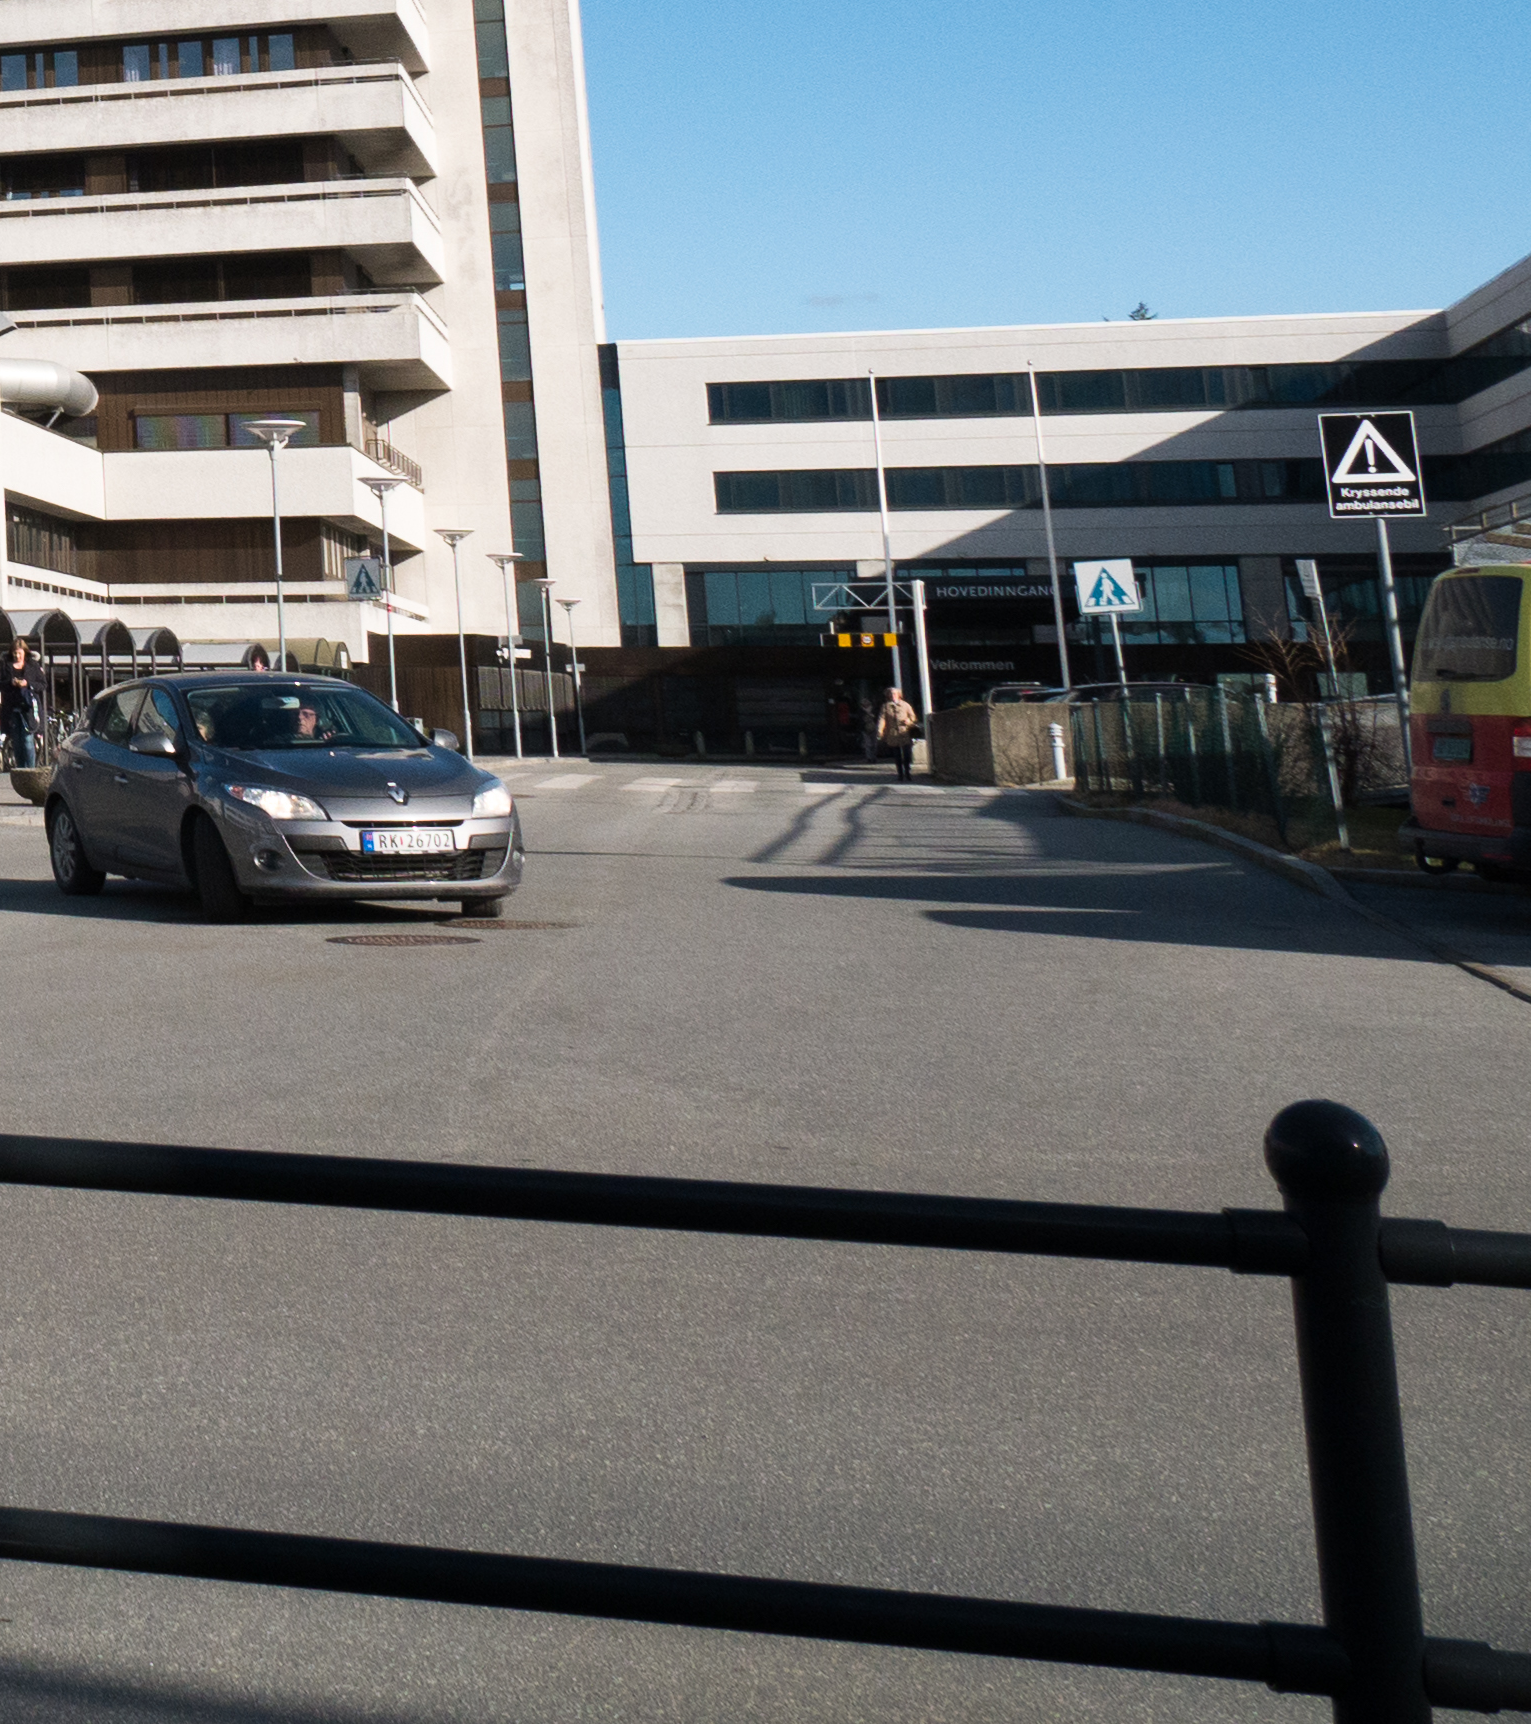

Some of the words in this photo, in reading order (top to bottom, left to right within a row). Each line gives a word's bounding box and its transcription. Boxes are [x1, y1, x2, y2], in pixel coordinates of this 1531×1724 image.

[1340, 486, 1410, 499] Kryssende
[1335, 498, 1420, 511] ambulansebil
[929, 659, 1015, 672] Velkommen
[378, 833, 399, 849] RK
[406, 833, 451, 848] 26702
